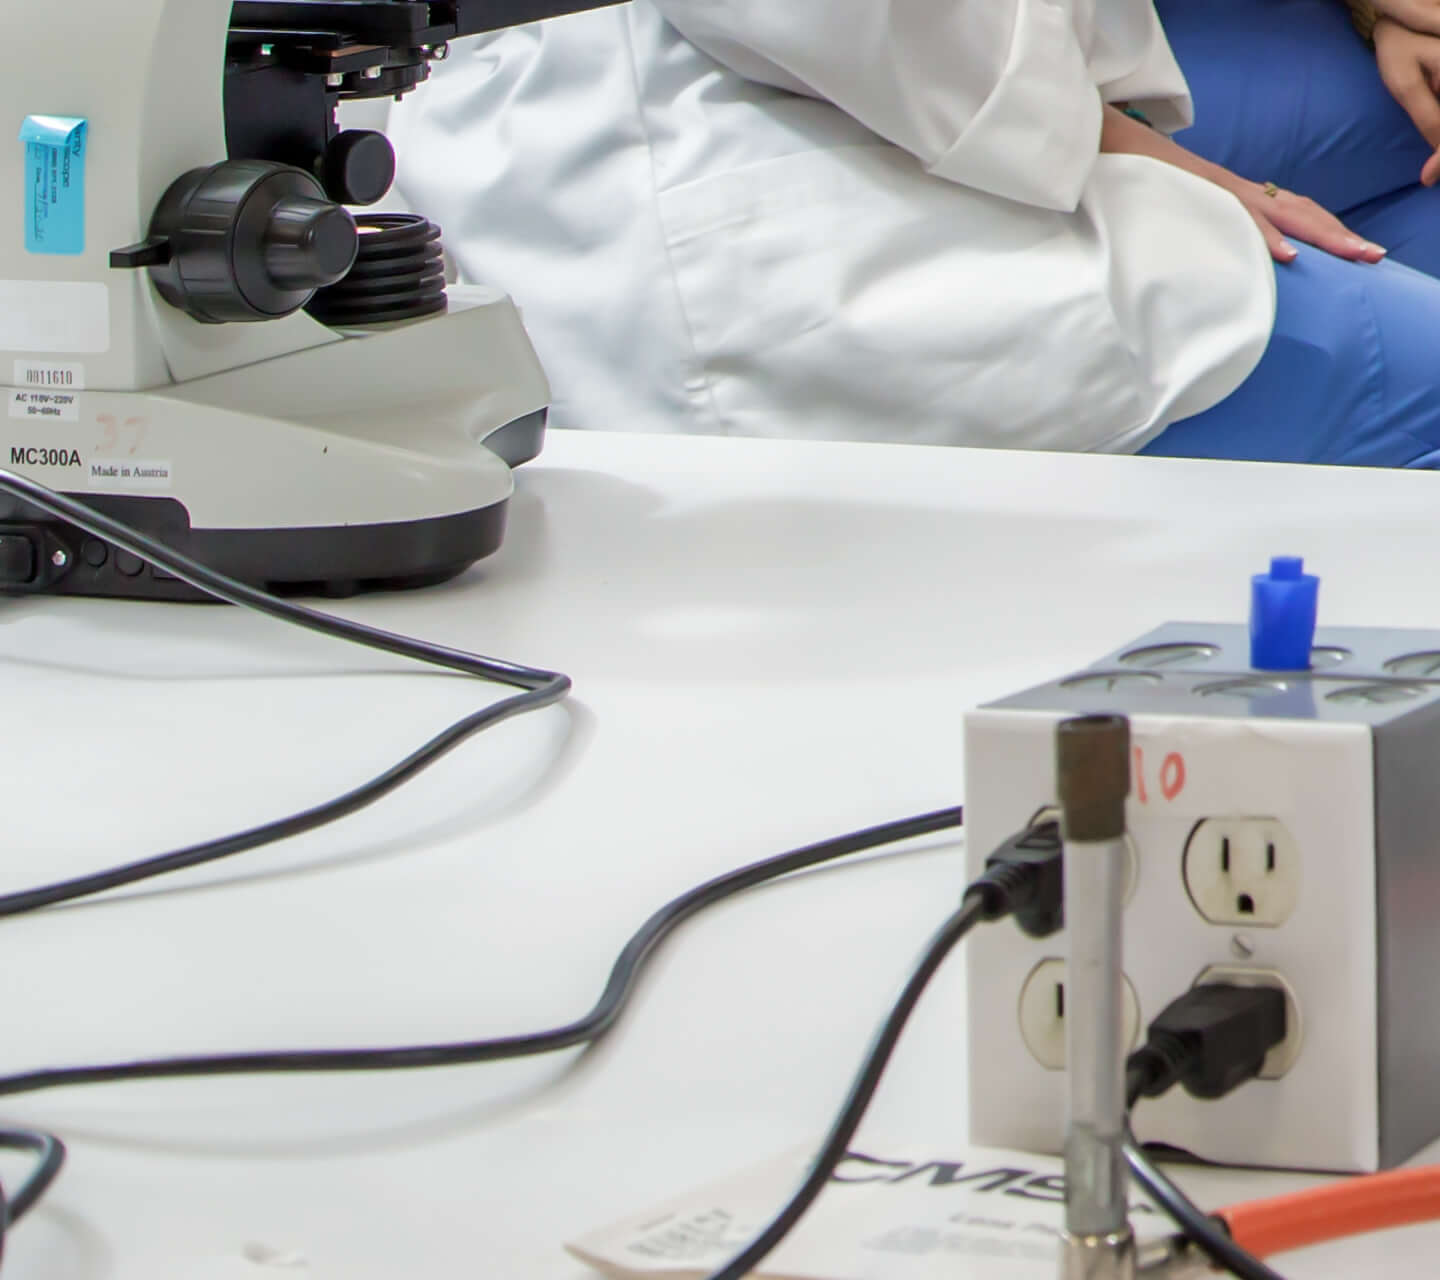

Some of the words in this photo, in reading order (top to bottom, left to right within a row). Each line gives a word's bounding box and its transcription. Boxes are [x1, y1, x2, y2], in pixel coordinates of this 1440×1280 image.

[10, 446, 82, 467] MC300A
[91, 465, 118, 477] Made
[121, 466, 131, 477] in
[133, 466, 169, 478] Austria
